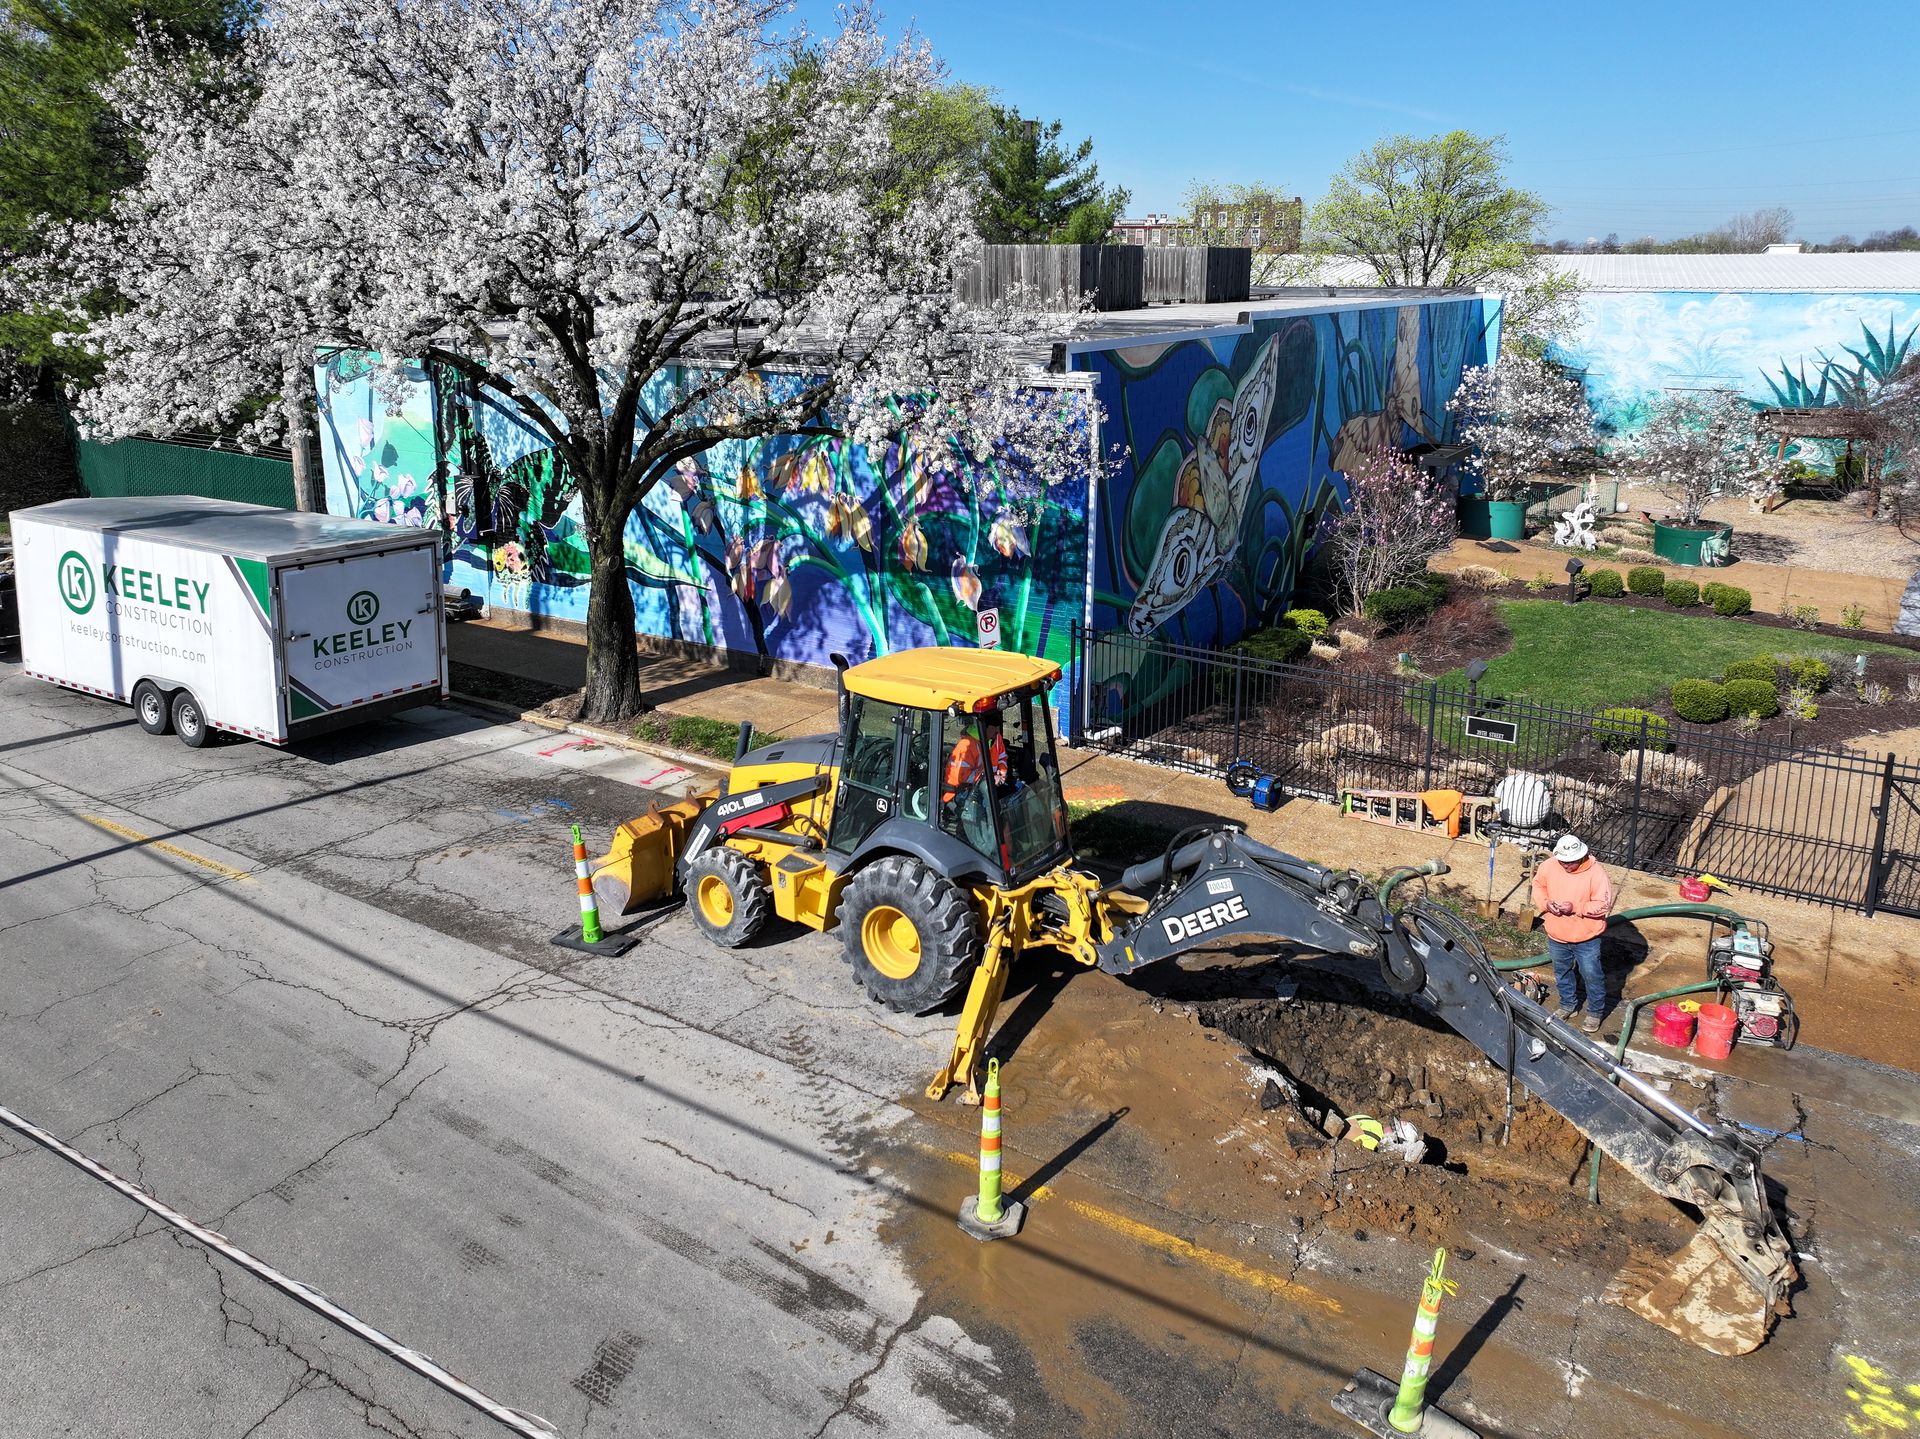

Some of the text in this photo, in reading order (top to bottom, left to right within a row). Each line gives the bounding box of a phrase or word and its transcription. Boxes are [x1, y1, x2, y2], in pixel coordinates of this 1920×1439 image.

[102, 563, 211, 614] KEELEY
[105, 600, 213, 636] CONSTRUCTION
[313, 618, 413, 659] KEELEY
[70, 620, 206, 664] keeleyconstruction.com
[314, 640, 414, 671] CONSTRUCTION
[716, 800, 745, 817] 410L
[1161, 894, 1250, 944] DEERE
